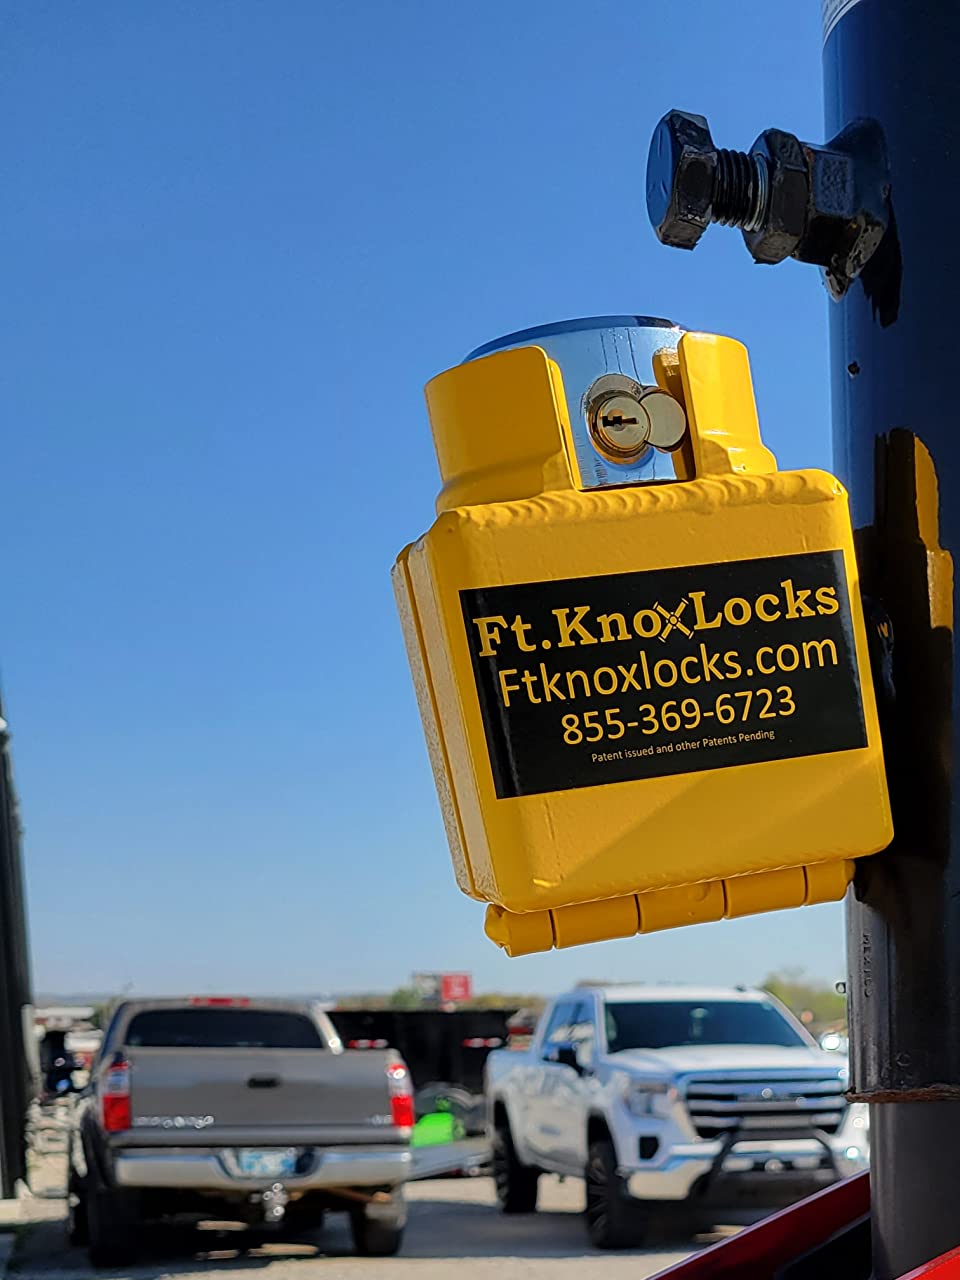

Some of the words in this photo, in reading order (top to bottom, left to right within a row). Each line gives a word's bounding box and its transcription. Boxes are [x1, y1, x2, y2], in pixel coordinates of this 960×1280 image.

[498, 638, 839, 708] Ftknoxlocks.com
[561, 685, 797, 745] 855-369-6723
[591, 751, 623, 763] Patent
[624, 745, 655, 759] issued
[656, 743, 674, 755] and
[675, 739, 701, 752] other
[702, 733, 737, 748] Patents
[738, 729, 776, 744] Pending
